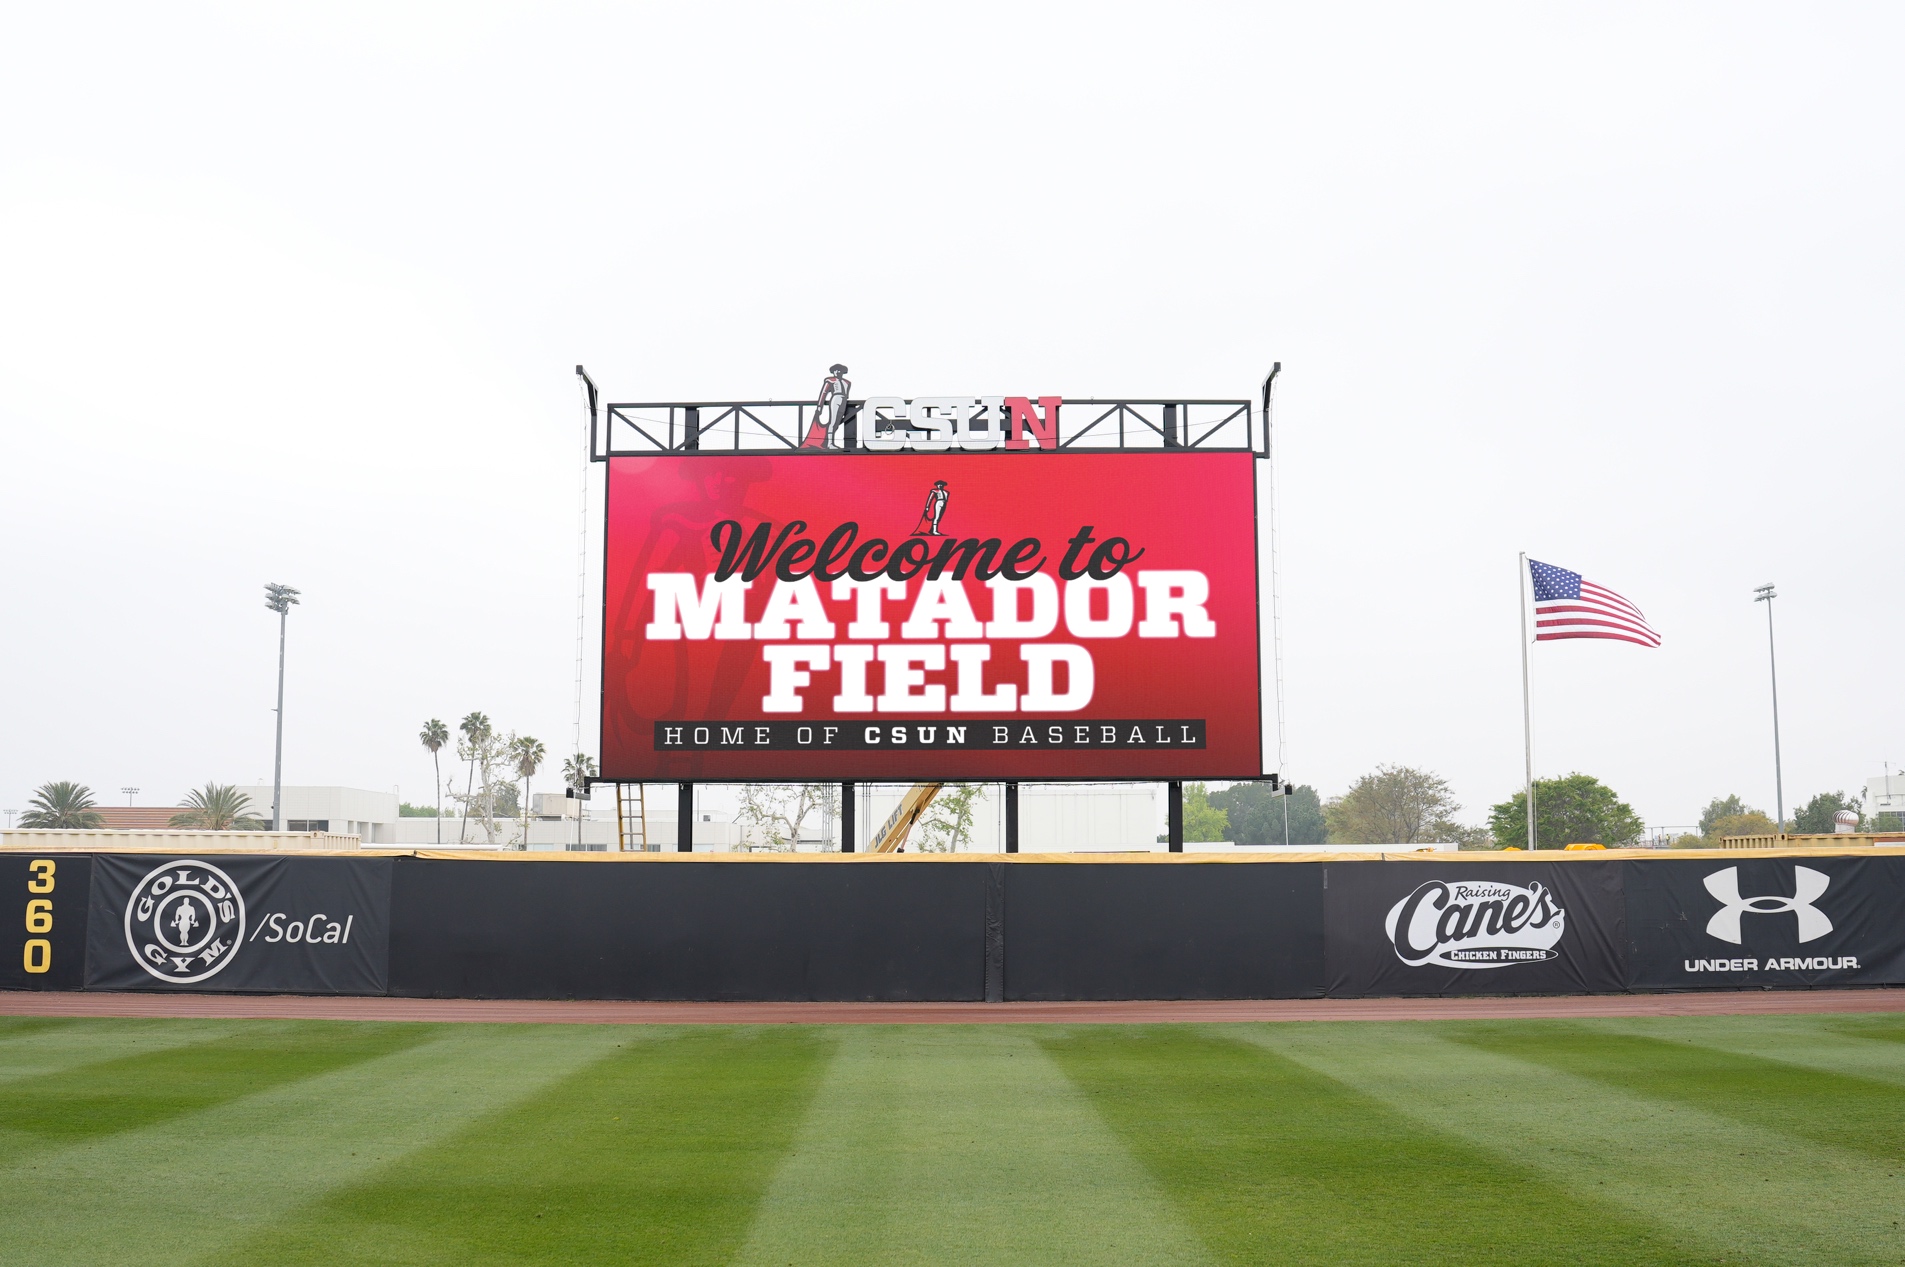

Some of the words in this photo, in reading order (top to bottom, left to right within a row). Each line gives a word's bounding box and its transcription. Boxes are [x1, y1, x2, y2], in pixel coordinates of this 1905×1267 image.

[862, 396, 1062, 452] CSUN
[709, 519, 1046, 583] Welcome
[1060, 525, 1145, 581] to
[645, 569, 1217, 641] MATADOR
[762, 643, 1096, 713] FIELD
[664, 727, 770, 745] HOME
[797, 727, 838, 744] OF
[864, 726, 967, 744] CSUN
[992, 726, 1196, 744] BASEBALL
[874, 825, 887, 849] JLG
[887, 803, 903, 831] LIFT
[137, 870, 236, 923] GOLD'S
[1455, 885, 1511, 901] Raising
[1394, 880, 1563, 961] Cane's
[144, 937, 230, 973] GYM
[1684, 958, 1759, 972] UNDER
